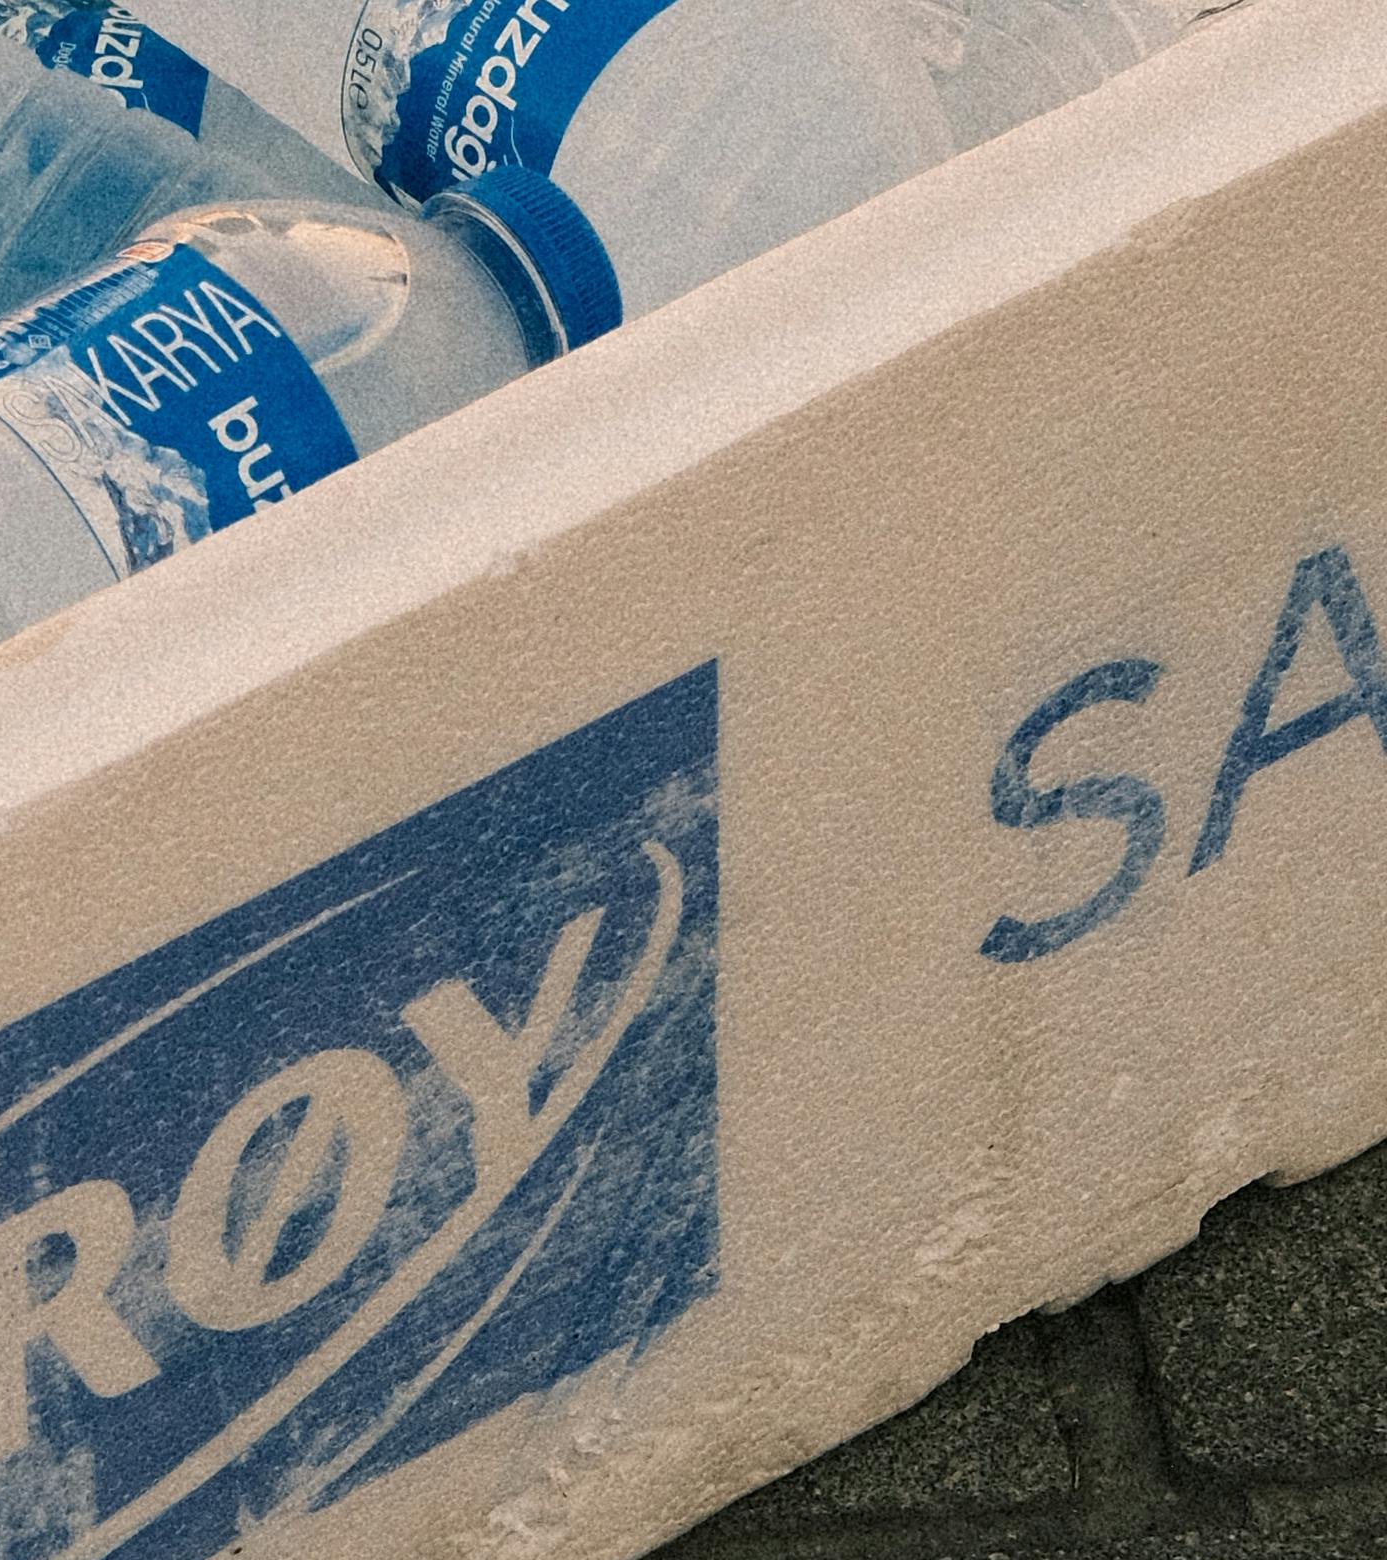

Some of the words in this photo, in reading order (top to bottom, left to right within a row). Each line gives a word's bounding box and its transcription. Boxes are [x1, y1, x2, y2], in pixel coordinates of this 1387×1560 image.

[442, 47, 472, 110] Mineral
[427, 107, 449, 162] Water
[3, 281, 281, 465] SAKARYA
